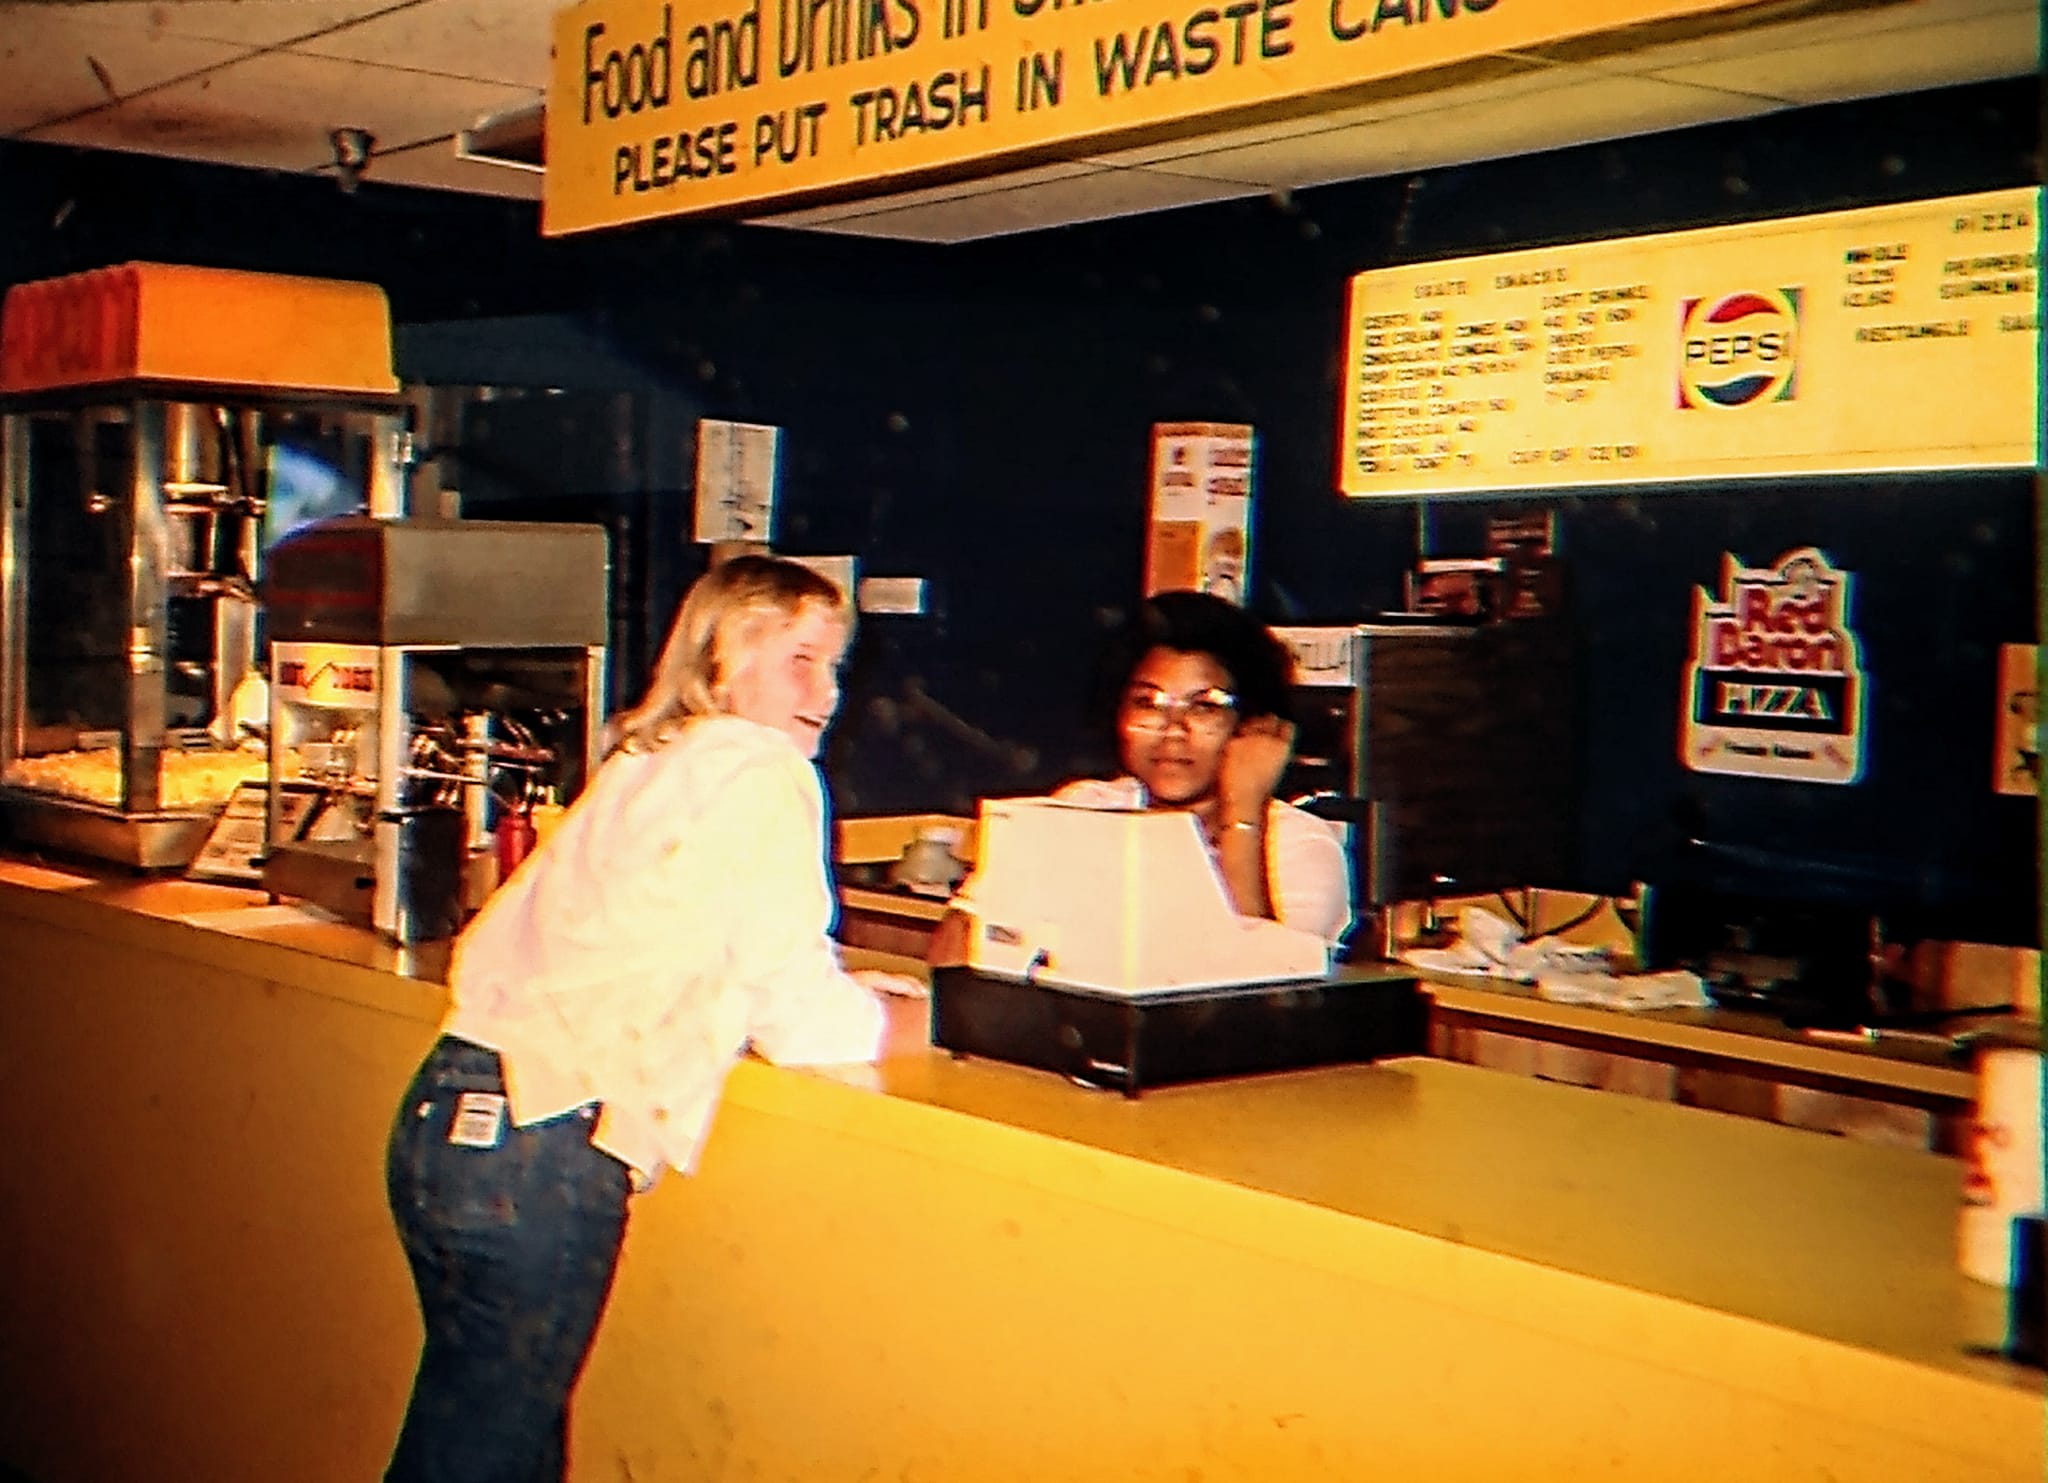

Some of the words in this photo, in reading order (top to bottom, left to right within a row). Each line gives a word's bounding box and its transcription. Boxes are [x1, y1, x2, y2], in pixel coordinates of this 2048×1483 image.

[583, 3, 671, 124] Food
[686, 8, 760, 98] and
[779, 0, 920, 78] Drinks
[614, 122, 738, 195] PLEASE
[753, 103, 828, 167] PUT
[850, 64, 991, 146] TRASH
[1016, 48, 1063, 113] IN
[1095, 0, 1296, 97] WASTE
[1330, 0, 1500, 41] CA
[1954, 212, 2030, 233] PIZZA
[1687, 332, 1791, 367] PEPSI
[1743, 584, 1832, 636] Red
[1714, 680, 1834, 721] PIZZA
